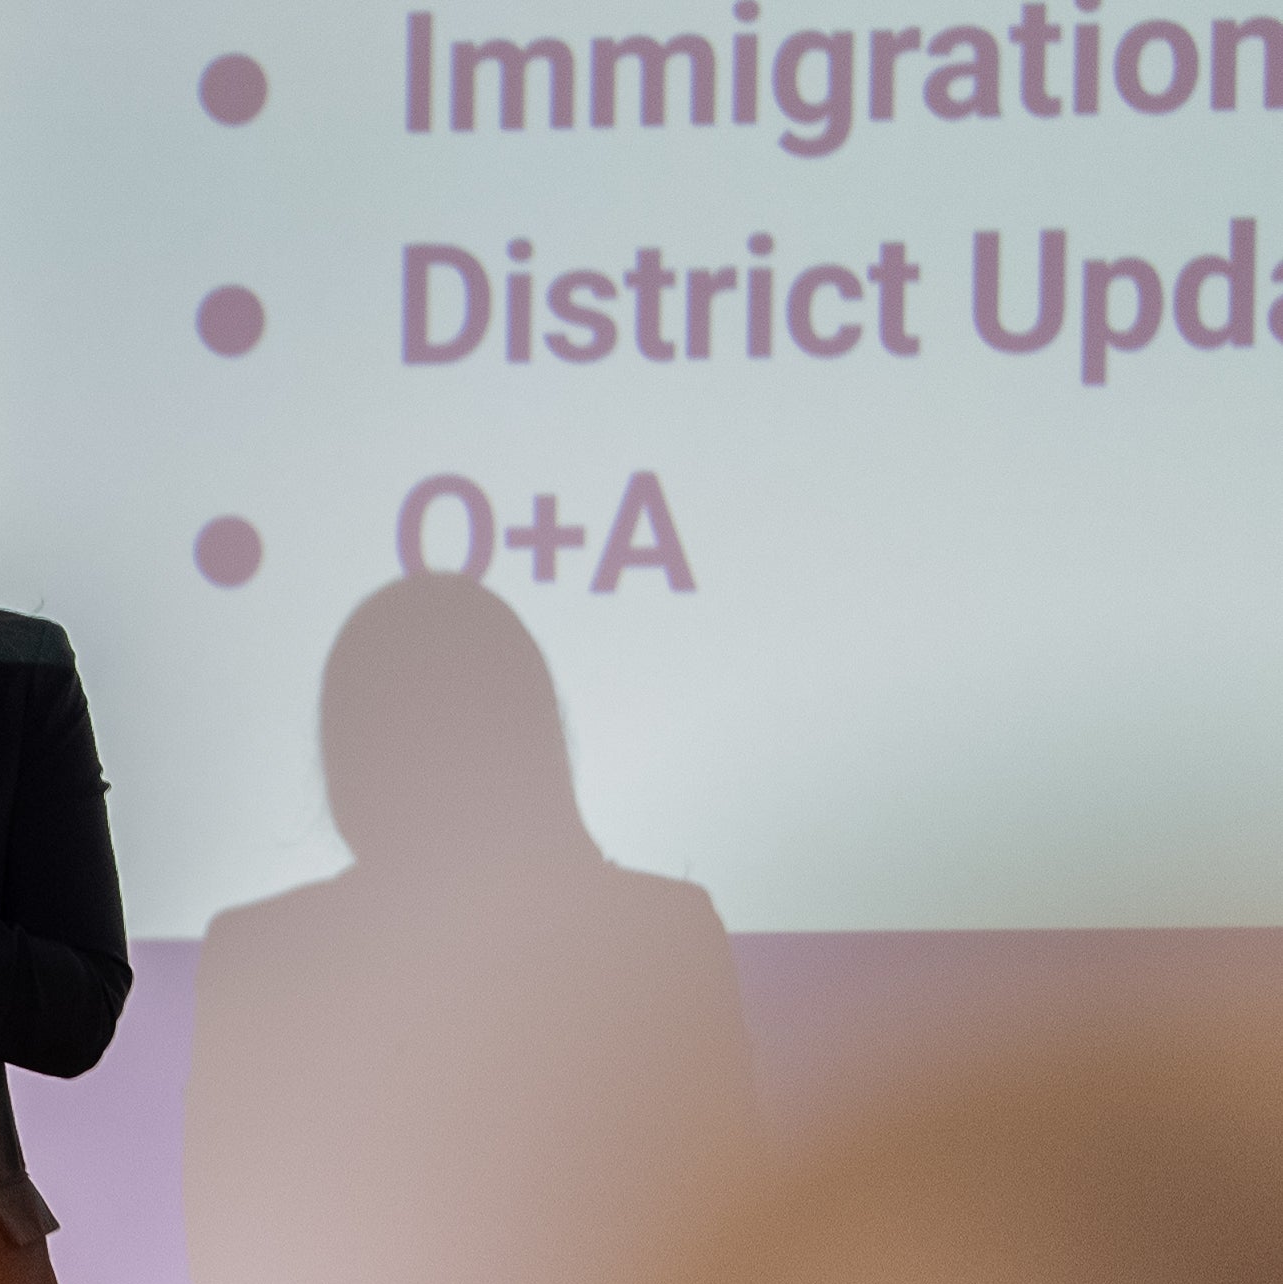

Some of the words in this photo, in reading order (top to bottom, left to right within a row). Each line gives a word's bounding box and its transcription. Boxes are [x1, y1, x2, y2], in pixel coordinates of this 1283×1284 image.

[405, 0, 1283, 158] Immigration
[401, 233, 921, 366] District
[971, 217, 1283, 387] Upd
